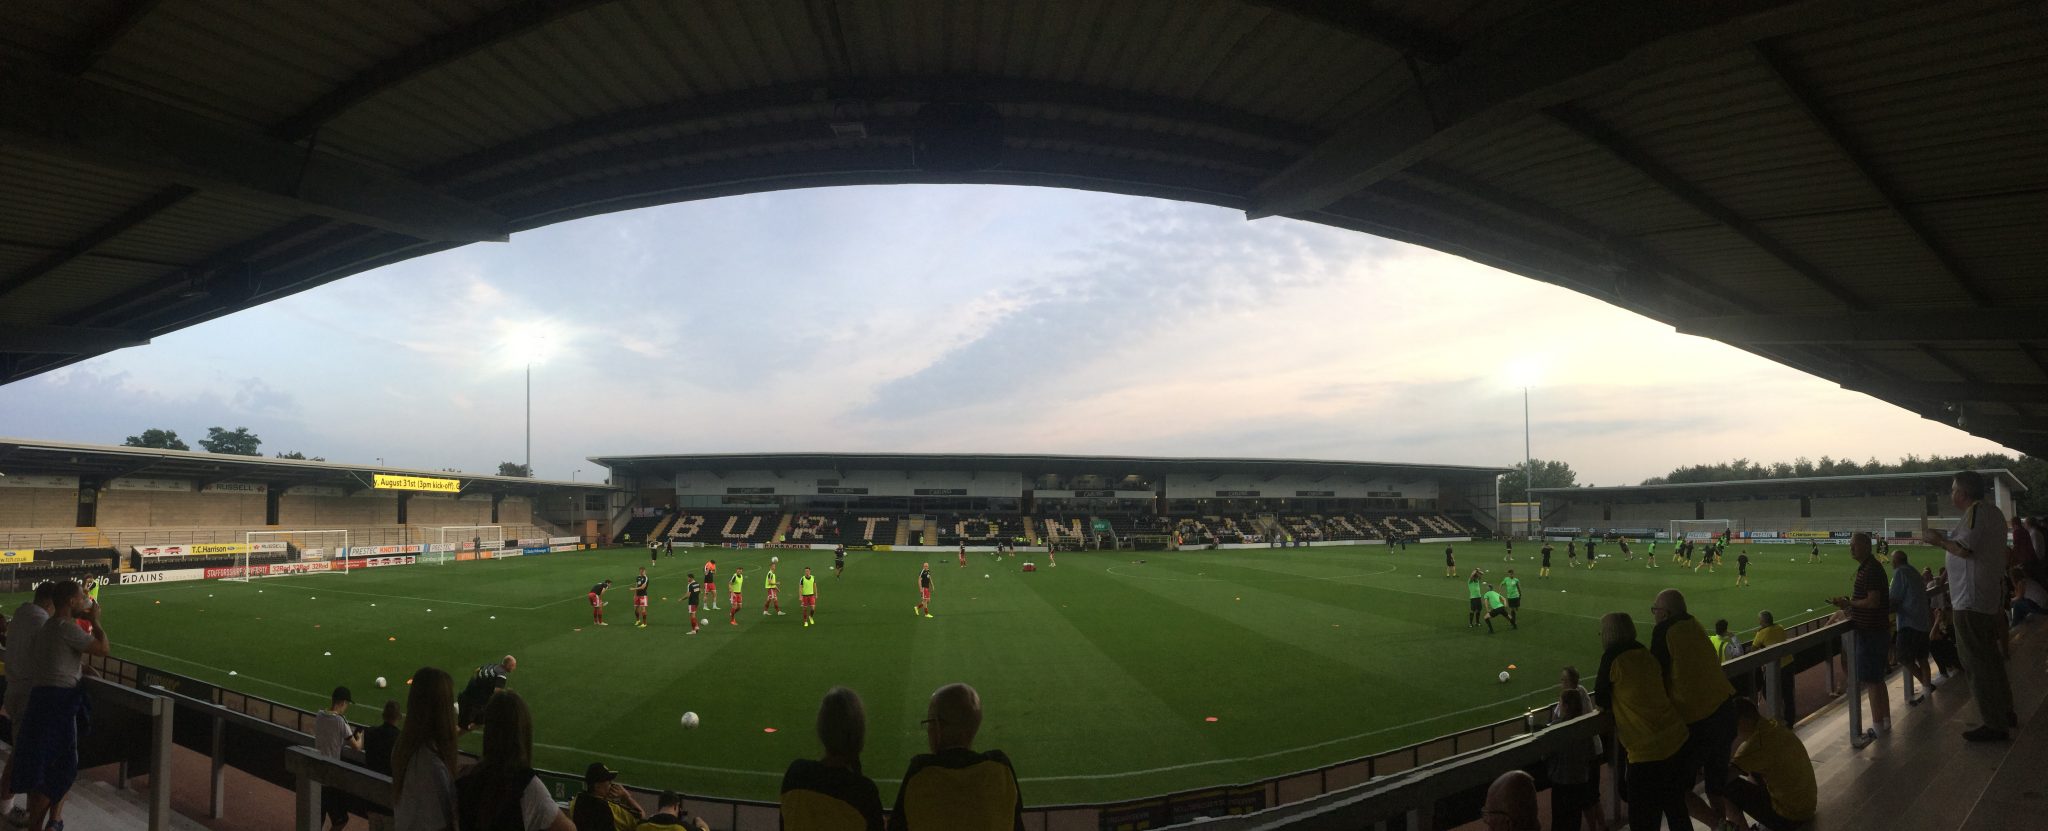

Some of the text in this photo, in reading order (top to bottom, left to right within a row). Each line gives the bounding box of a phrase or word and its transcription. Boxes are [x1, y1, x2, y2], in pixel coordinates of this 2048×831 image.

[381, 478, 402, 488] August
[403, 479, 416, 487] 31st
[417, 480, 431, 489] (3pm
[352, 546, 378, 555] PRESTEC
[131, 572, 164, 582] DAINS
